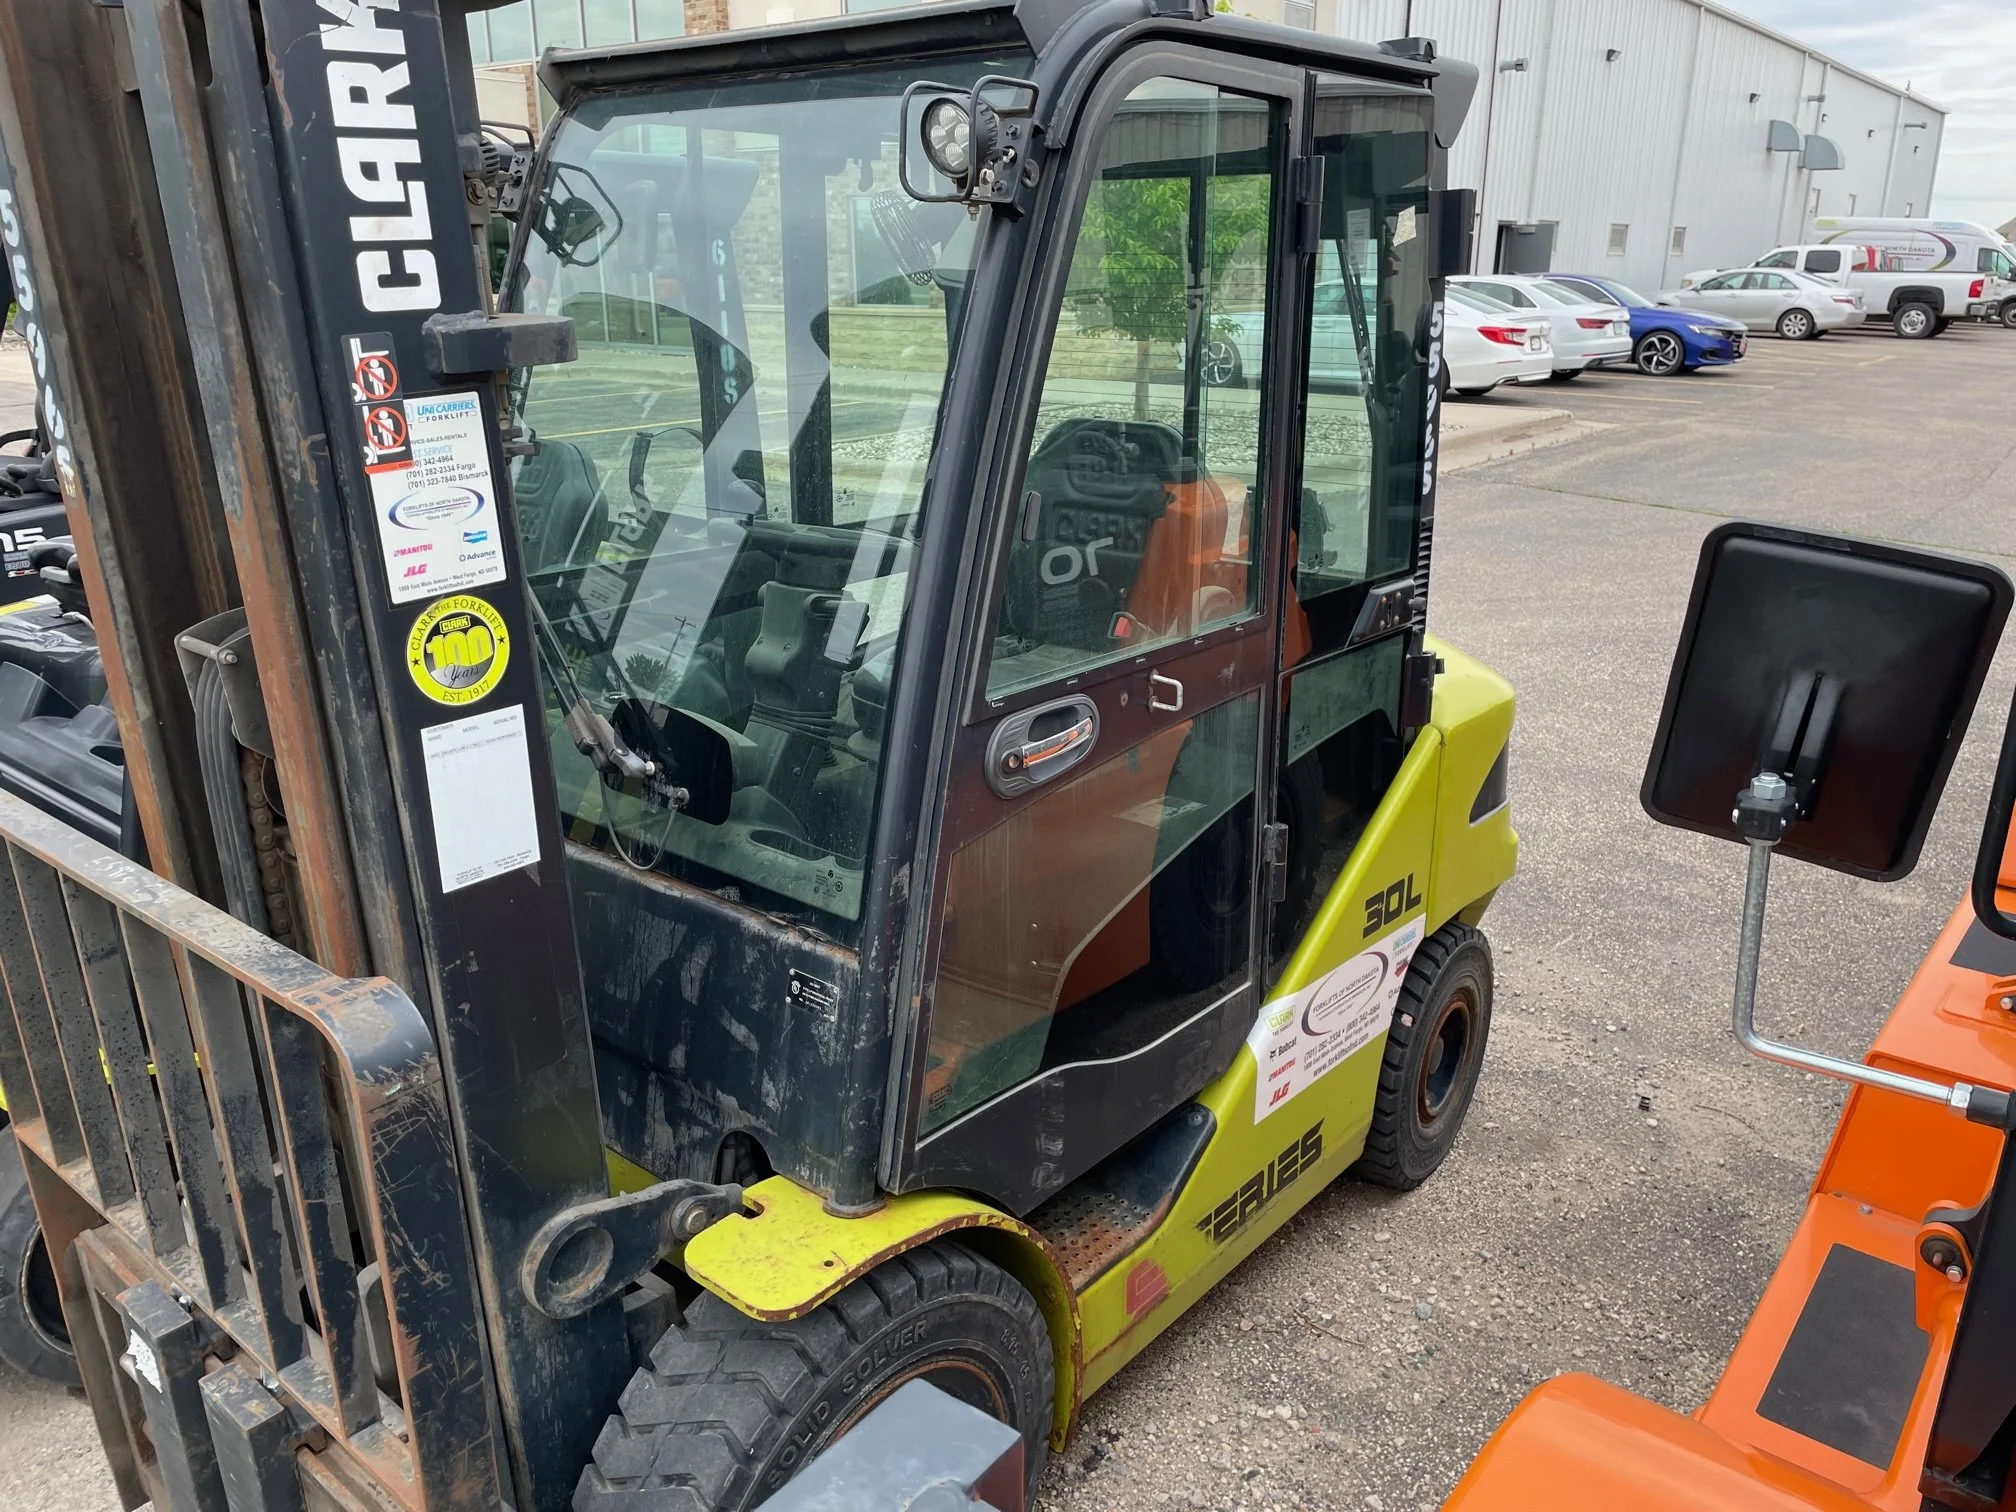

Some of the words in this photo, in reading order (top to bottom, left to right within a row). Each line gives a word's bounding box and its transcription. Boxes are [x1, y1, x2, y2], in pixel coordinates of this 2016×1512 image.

[317, 0, 442, 312] CLARK
[417, 401, 477, 416] UNICARRIERS
[426, 411, 470, 423] FORKLIFT
[424, 455, 454, 467] 342-4964
[406, 470, 423, 480] (701)
[425, 465, 455, 476] 282-2334
[456, 463, 476, 472] Fargo
[408, 480, 425, 490] (701)
[458, 470, 489, 481] Bismarck
[403, 503, 429, 512] FORKLIFTS
[452, 496, 471, 504] DAKOTA
[400, 543, 433, 556] MANITOU
[467, 550, 496, 561] Advance
[403, 563, 428, 578] JLG
[452, 573, 462, 581] West
[411, 611, 436, 651] CLARK
[435, 601, 451, 612] THE
[453, 599, 503, 631] FORKLIFT
[442, 618, 469, 631] CLARK
[426, 625, 494, 670] 100
[444, 663, 480, 688] Years
[442, 690, 466, 702] EST.
[468, 680, 490, 700] 1917
[1362, 872, 1422, 939] 30L
[1312, 992, 1339, 1014] FORKLIFTS
[1346, 979, 1362, 993] NORTH
[1362, 966, 1380, 983] DAKOTA
[1269, 1008, 1295, 1028] CLARK
[1278, 1036, 1297, 1057] Bobcat
[1304, 1046, 1318, 1064] (701)
[1269, 1081, 1291, 1107] JLG
[767, 1400, 832, 1489] SOLID
[842, 1319, 929, 1394] SOLVER
